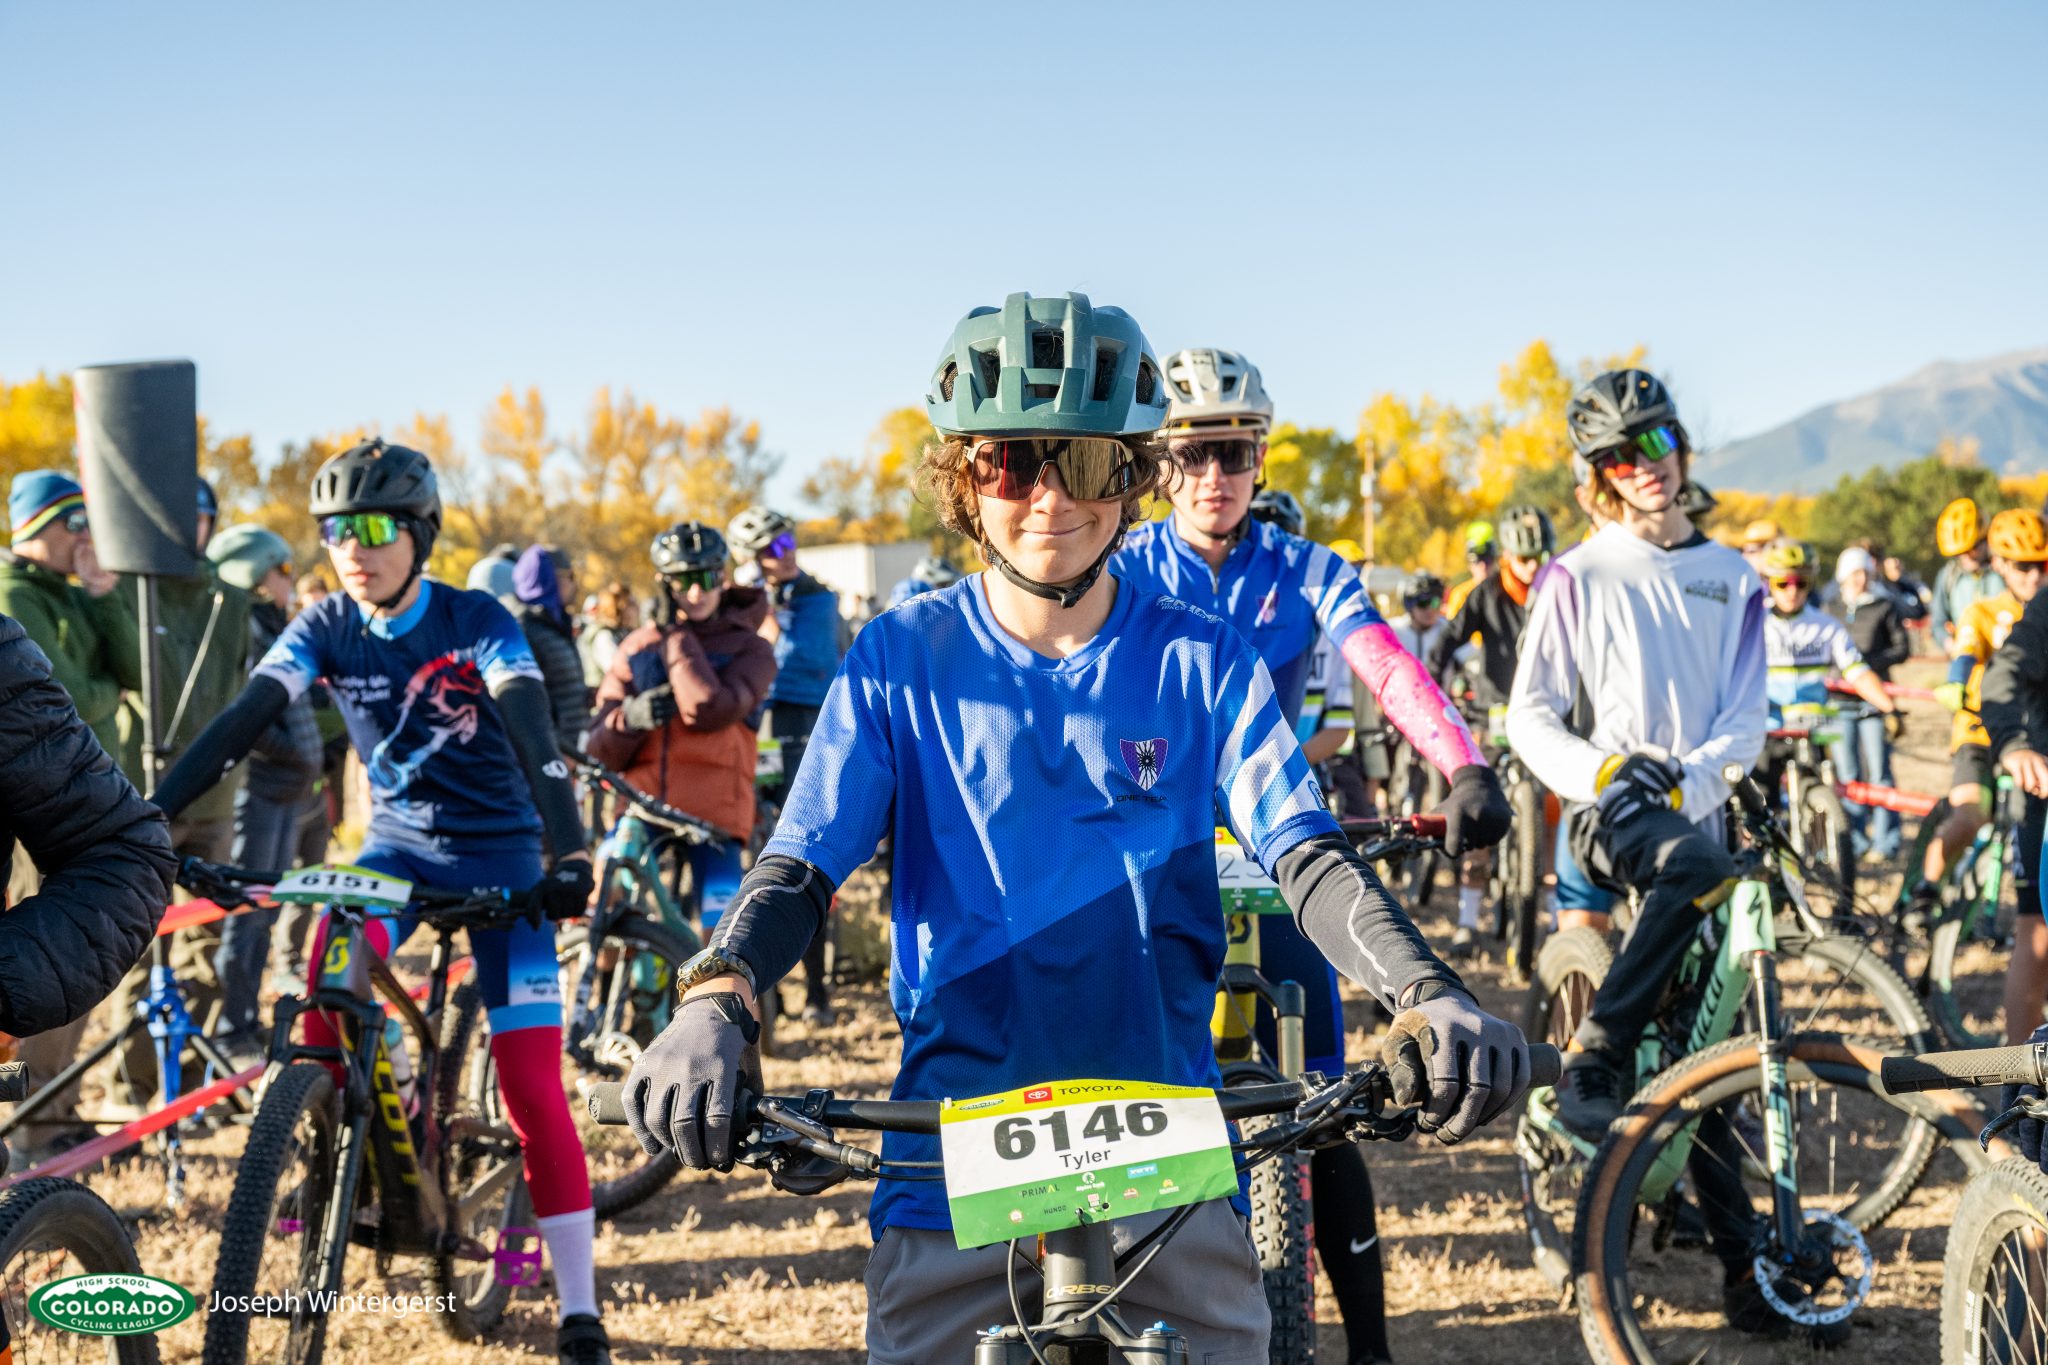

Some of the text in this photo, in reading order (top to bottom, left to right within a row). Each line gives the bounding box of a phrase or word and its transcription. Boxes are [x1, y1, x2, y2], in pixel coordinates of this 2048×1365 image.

[301, 872, 380, 891] 6151
[1058, 1084, 1126, 1096] TOYOTA
[993, 1102, 1169, 1161] 6146
[1059, 1148, 1112, 1170] Tyler
[1021, 1183, 1061, 1199] PRIMAL
